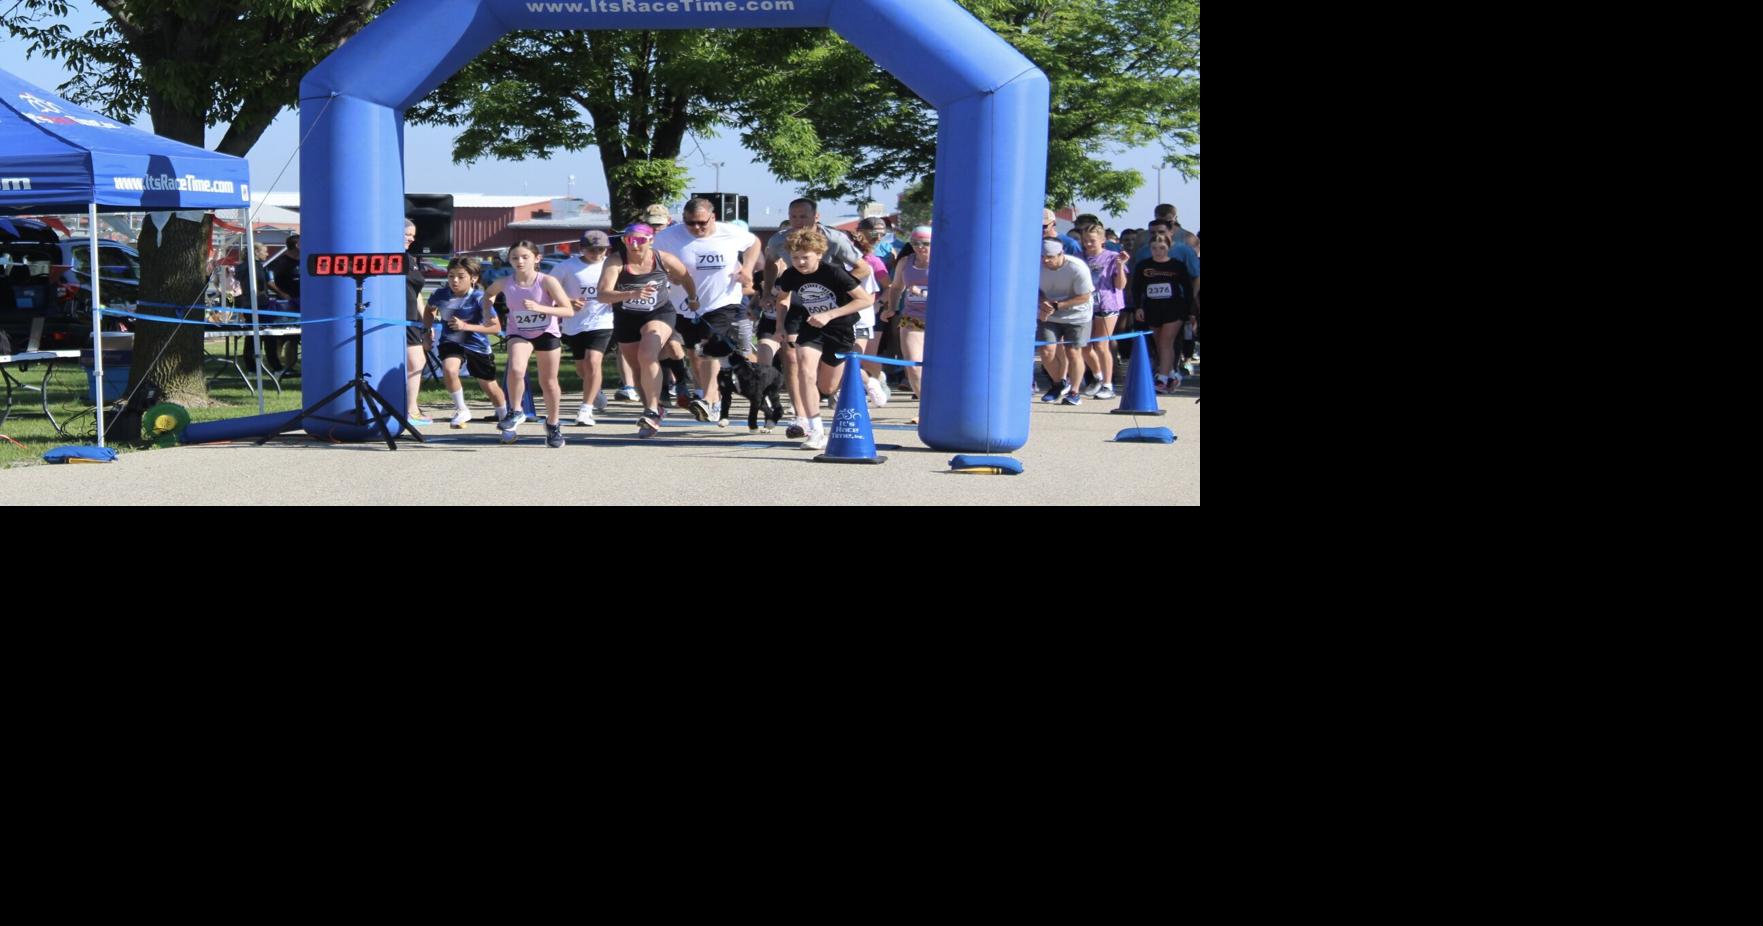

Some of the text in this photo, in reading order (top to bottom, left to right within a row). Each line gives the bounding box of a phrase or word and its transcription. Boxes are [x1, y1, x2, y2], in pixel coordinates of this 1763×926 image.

[526, 0, 794, 12] www.ItsRaceTime.com
[113, 174, 234, 193] www.ItsRaceTime.com
[698, 254, 724, 263] 7011
[515, 313, 547, 324] 2479
